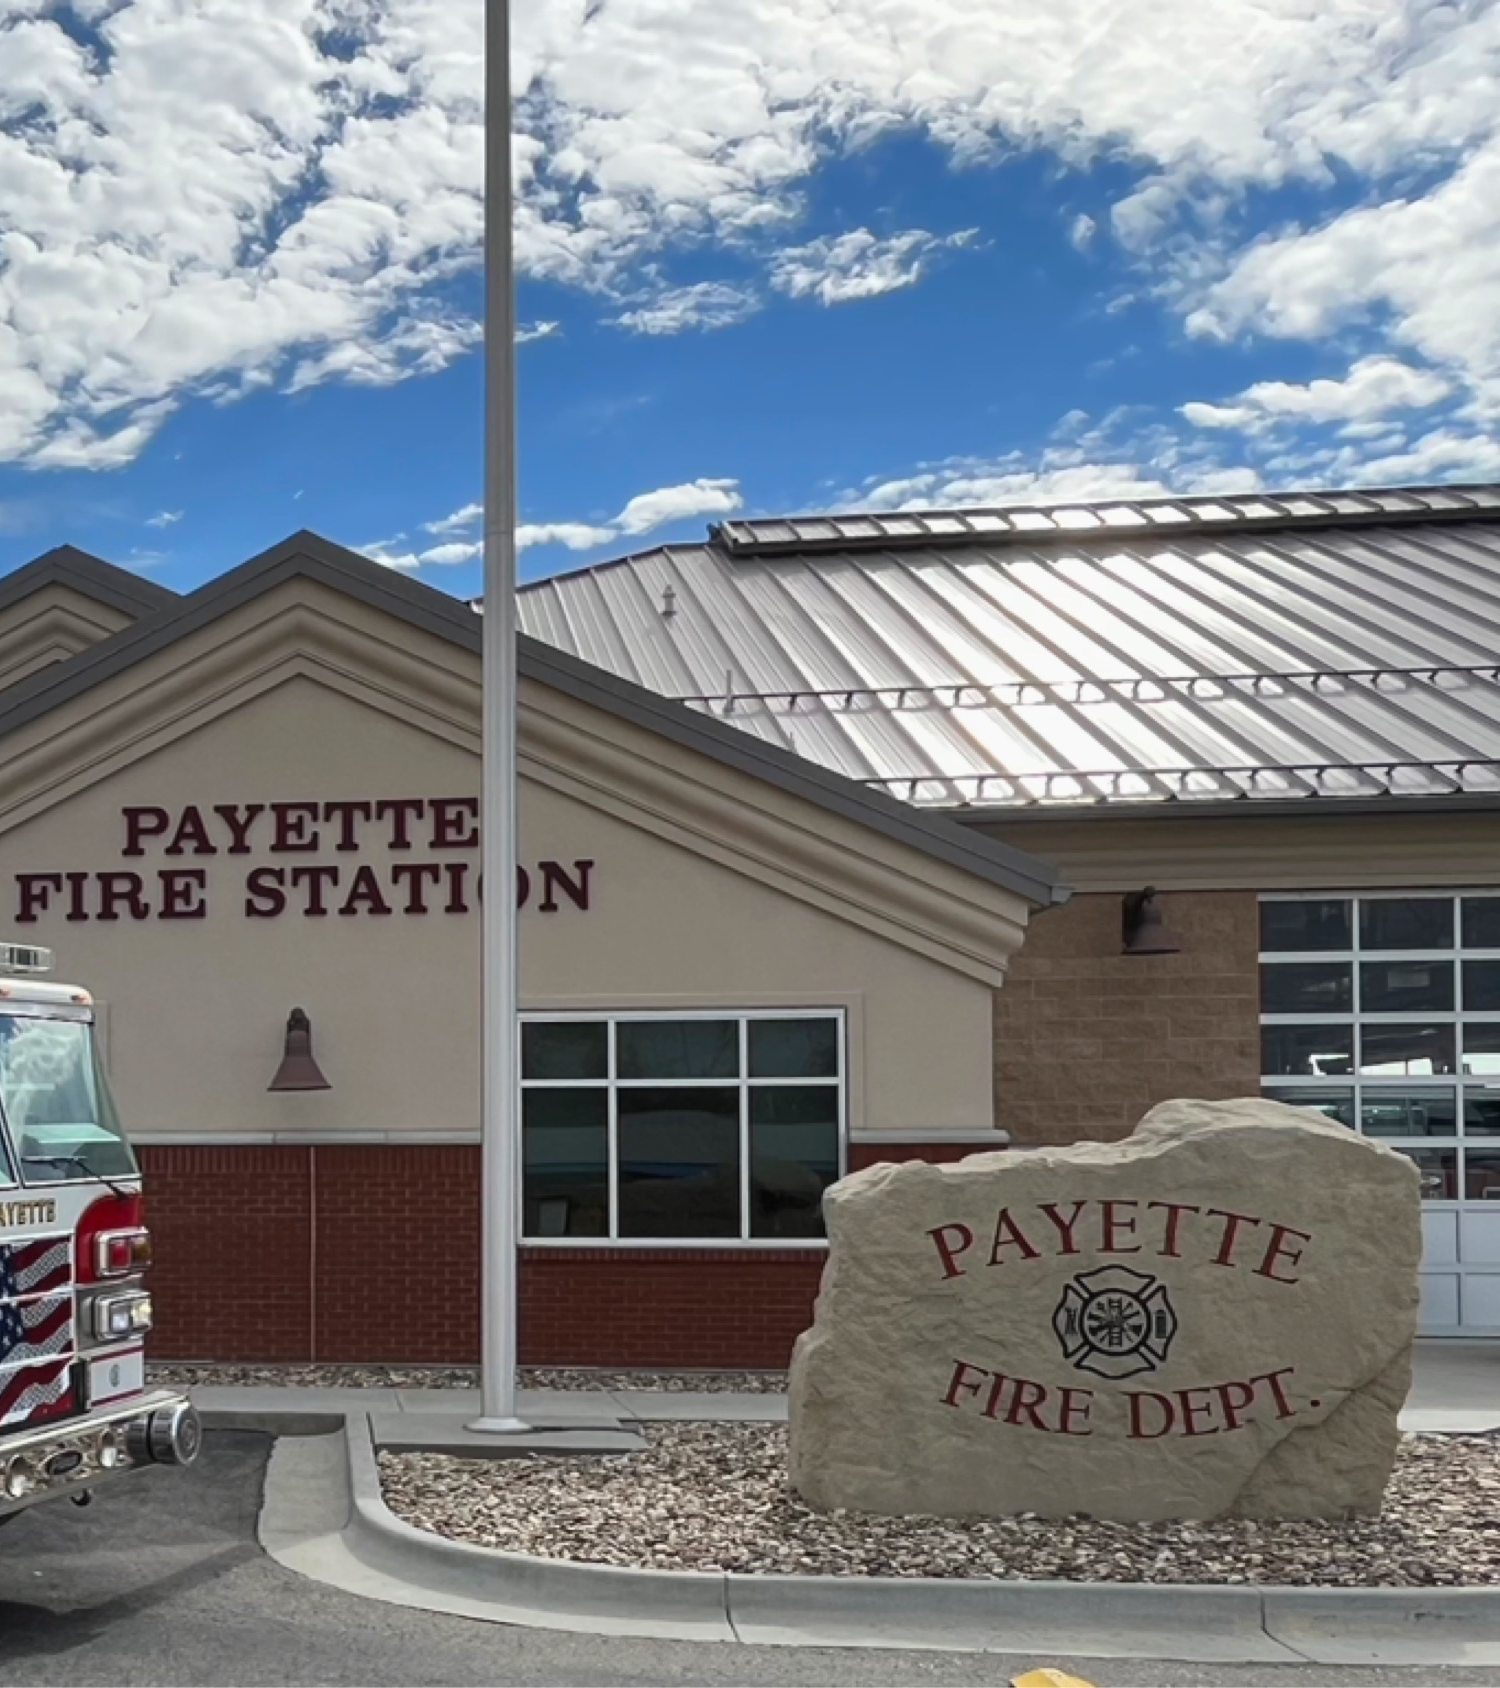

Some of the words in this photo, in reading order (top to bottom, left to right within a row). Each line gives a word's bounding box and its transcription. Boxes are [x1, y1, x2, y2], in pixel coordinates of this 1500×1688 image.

[122, 797, 479, 856] PAYETTE
[15, 869, 206, 922] FIRE
[926, 1199, 1312, 1284] PAYETTE
[940, 1359, 1094, 1436] FIRE
[1121, 1367, 1321, 1439] DEPT.
